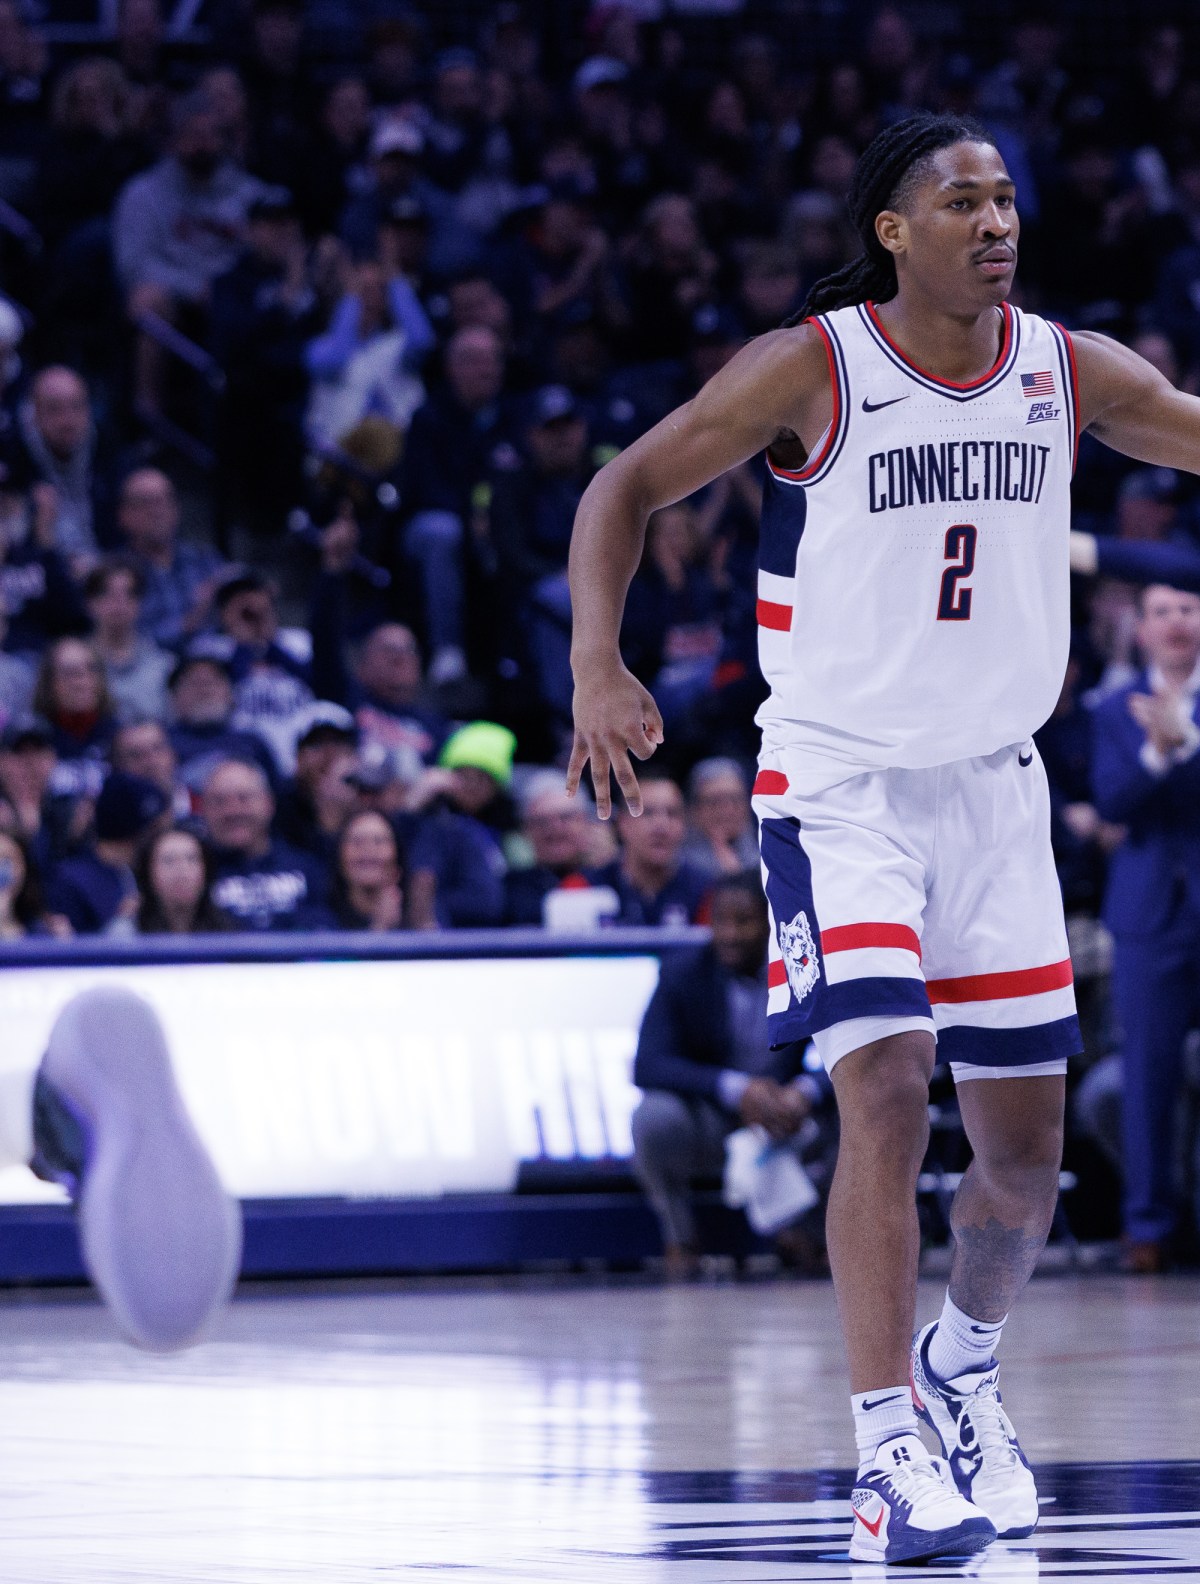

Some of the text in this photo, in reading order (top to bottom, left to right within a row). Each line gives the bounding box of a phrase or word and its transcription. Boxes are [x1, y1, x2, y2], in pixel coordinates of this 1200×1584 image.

[1027, 409, 1061, 421] EAST
[1030, 402, 1053, 412] BIG
[869, 441, 1051, 513] CONNECTICUT
[936, 524, 977, 621] 2
[227, 1032, 476, 1162] NOW
